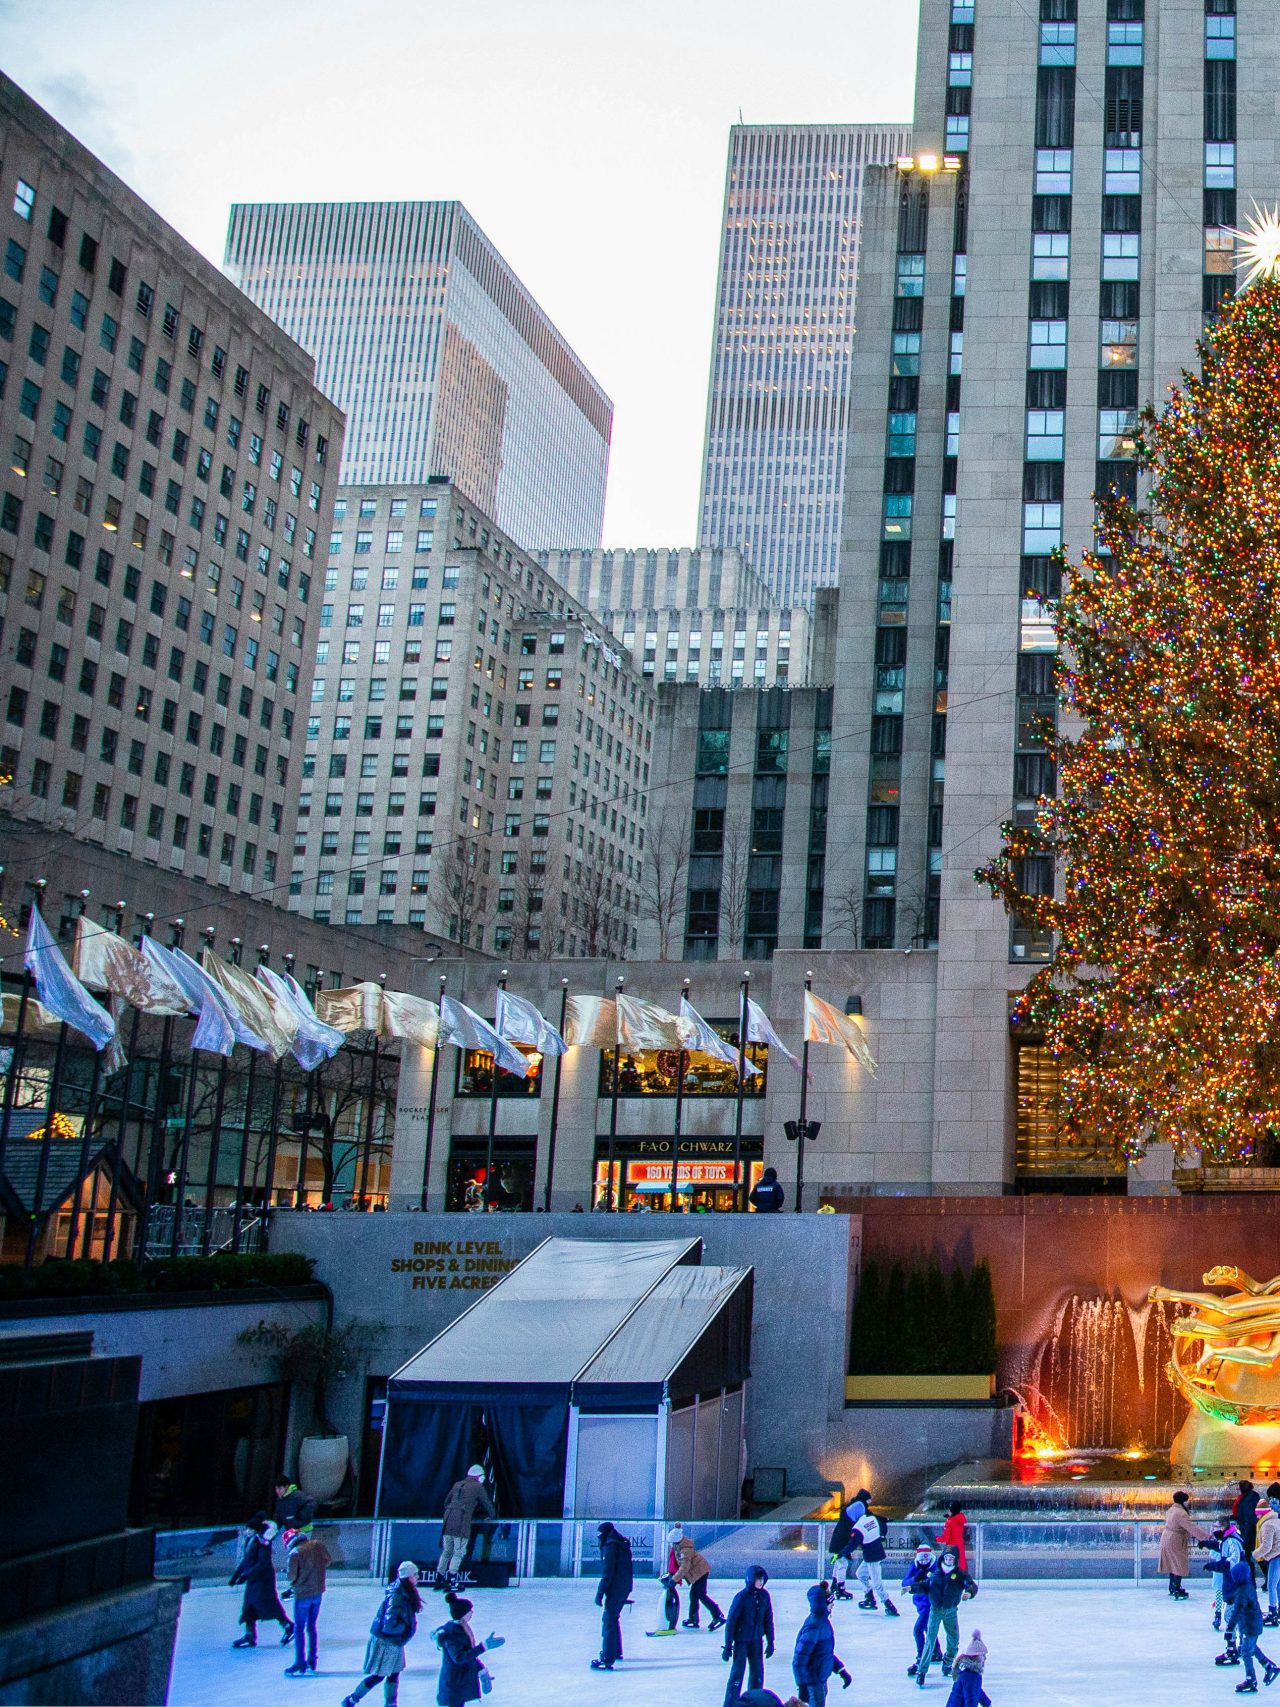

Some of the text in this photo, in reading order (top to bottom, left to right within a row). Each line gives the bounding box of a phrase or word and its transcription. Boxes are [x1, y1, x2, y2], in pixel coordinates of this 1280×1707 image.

[678, 1142, 733, 1152] CHWARZ
[646, 1166, 661, 1179] 160
[692, 1166, 702, 1179] OF
[705, 1166, 726, 1179] TOYS
[413, 1241, 502, 1254] RINK LEVEL
[391, 1259, 445, 1272] SHOPS
[448, 1260, 459, 1272] &
[412, 1276, 446, 1289] FIVE
[629, 1536, 649, 1547] INK
